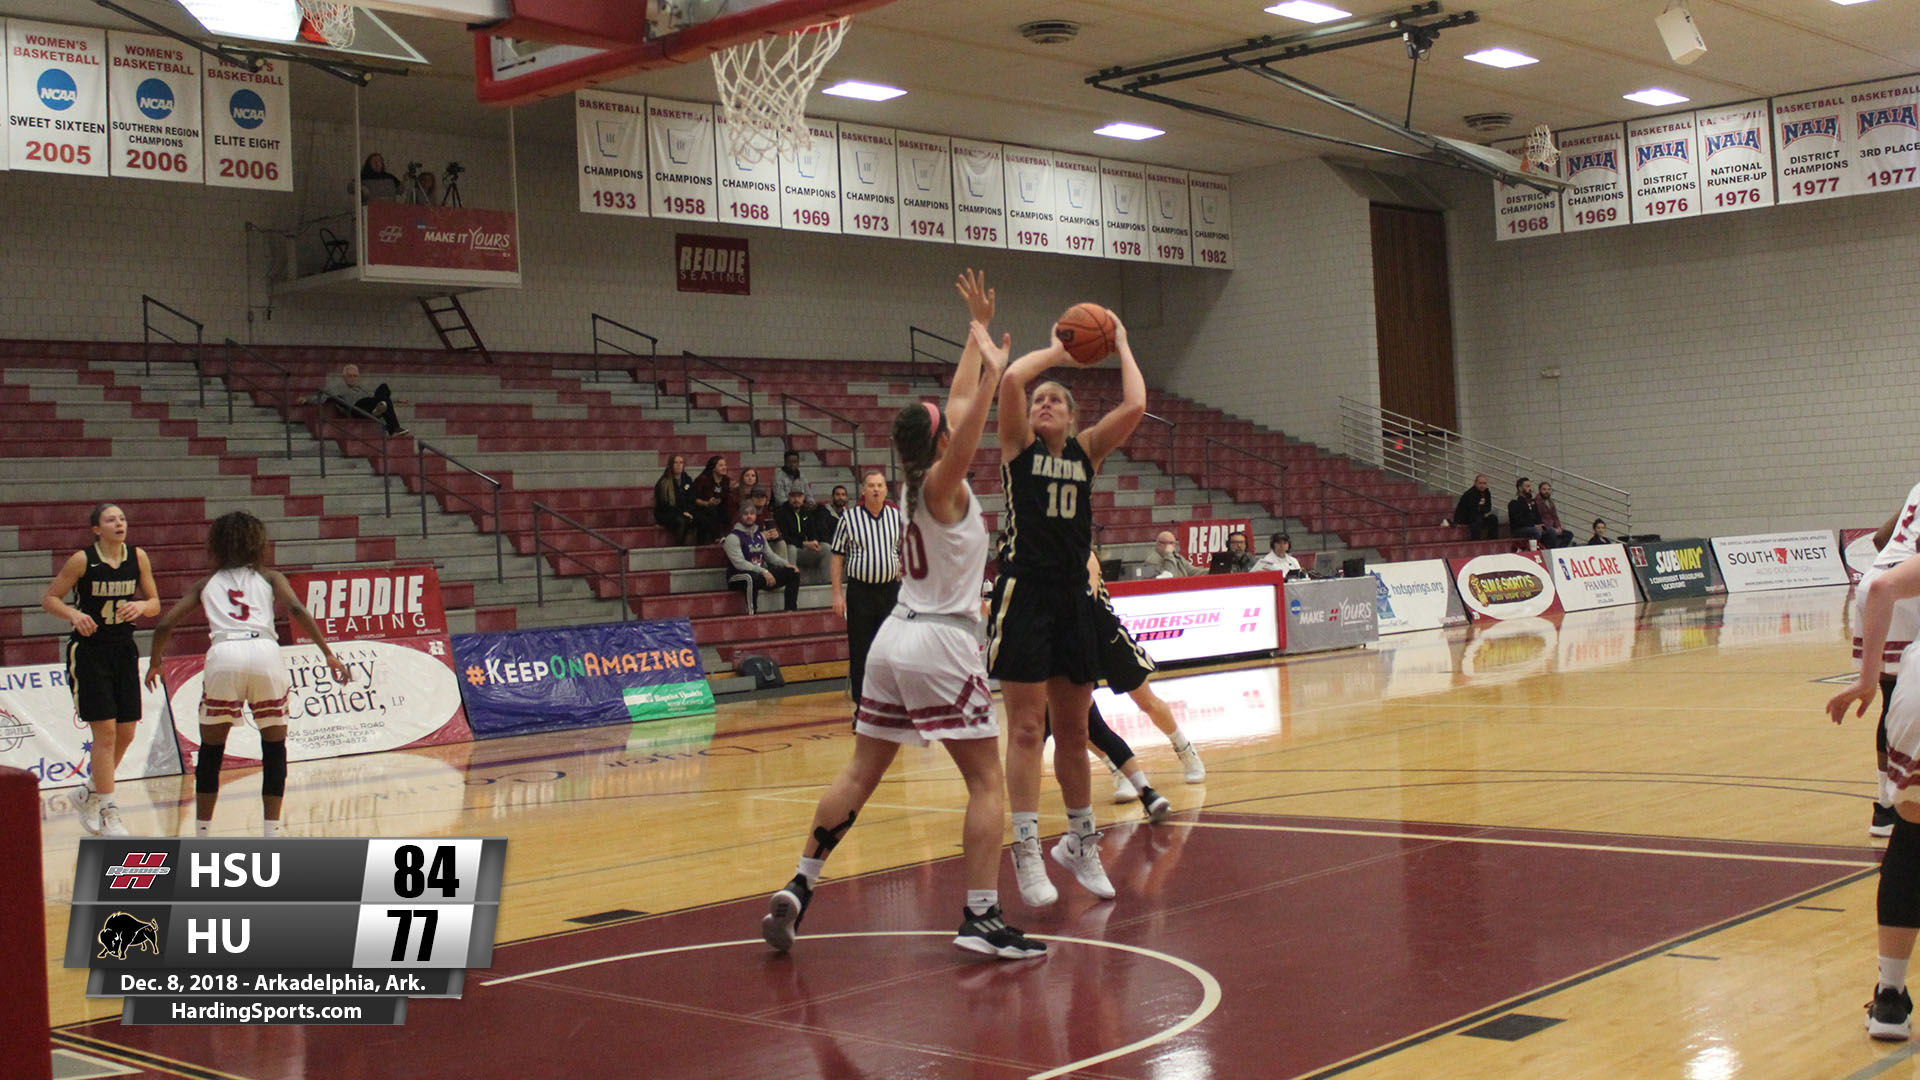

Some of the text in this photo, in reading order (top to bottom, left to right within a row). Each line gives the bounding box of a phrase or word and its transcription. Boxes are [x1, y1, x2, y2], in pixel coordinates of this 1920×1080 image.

[25, 34, 88, 51] WOMEN'S
[13, 47, 100, 66] BASKETBALL
[124, 45, 183, 61] WOMEN'S
[113, 57, 194, 76] BASKETBALL
[208, 69, 284, 86] BASKETBALL
[40, 87, 76, 102] NCAA
[140, 97, 174, 111] NCAA
[579, 99, 640, 114] BASKETBALL
[1776, 97, 1845, 114] BASKETBALL
[232, 107, 265, 120] NCAA
[10, 115, 105, 134] SWEET SIXTEEN
[112, 121, 199, 138] SOUTHERN REGION
[1630, 121, 1692, 138] BASKETBALL
[1859, 106, 1918, 138] NAIA
[841, 131, 893, 146] BASKETBALL
[1561, 132, 1620, 148] BASKETBALL
[1784, 117, 1838, 149] NAIA
[129, 135, 184, 148] CHAMPIONS
[214, 135, 280, 151] ELITE EIGHT
[1706, 130, 1760, 157] NAIA
[26, 141, 92, 165] 2005
[1638, 141, 1688, 166] NAIA
[1790, 150, 1840, 165] DISTRICT
[1860, 142, 1920, 158] 3RD PLACE
[126, 149, 188, 173] 2006
[1055, 160, 1097, 173] BASKETBALL
[1568, 150, 1616, 176] NAIA
[1710, 162, 1763, 176] NATIONAL
[1784, 160, 1848, 176] CHAMPIONS
[220, 158, 279, 181] 2006
[584, 165, 643, 180] CHAMPIONS
[1102, 167, 1144, 180] BASKETBALL
[1867, 167, 1916, 187] 1977
[655, 172, 713, 186] CHAMPIONS
[722, 178, 776, 192] CHAMPIONS
[1643, 172, 1688, 185] DISTRICT
[1707, 171, 1767, 188] RUNNER-UP
[1792, 177, 1839, 196] 1977
[785, 185, 836, 199] CHAMPIONS
[1573, 182, 1617, 195] DISTRICT
[1637, 182, 1696, 197] CHAMPIONS
[592, 190, 637, 210] 1933
[846, 191, 895, 204] CHAMPIONS
[903, 198, 949, 211] CHAMPIONS
[1568, 192, 1624, 206] CHAMPIONS
[1715, 188, 1760, 206] 1976
[663, 196, 706, 215] 1958
[730, 202, 769, 220] 1968
[958, 203, 1002, 216] CHAMPIONS
[1501, 201, 1556, 215] CHAMPIONS
[1645, 198, 1688, 216] 1976
[792, 209, 830, 227] 1969
[853, 214, 889, 231] 1973
[1010, 209, 1053, 221] CHAMPIONS
[1059, 214, 1100, 227] CHAMPIONS
[1575, 207, 1617, 225] 1969
[910, 219, 945, 237] 1974
[1107, 220, 1146, 232] CHAMPIONS
[1151, 224, 1188, 237] CHAMPIONS
[1508, 216, 1549, 234] 1968
[424, 226, 511, 250] MAKE IT YOURS
[964, 225, 998, 242] 1975
[1017, 231, 1049, 247] 1976
[1194, 229, 1230, 241] CHAMPIONS
[1065, 235, 1094, 252] 1977
[1112, 241, 1141, 256] 1978
[680, 246, 746, 273] REDDIE
[1157, 245, 1185, 260] 1979
[1200, 249, 1228, 264] 1982
[680, 270, 746, 285] SEATING
[1046, 482, 1079, 519] 10
[1656, 546, 1703, 574] SUBWAY
[1727, 546, 1827, 565] SOUTH WEST
[1391, 581, 1445, 596] hotsprings.org
[227, 589, 250, 621] 5
[306, 575, 424, 620] REDDIE
[1300, 611, 1325, 625] MAKE
[1339, 598, 1372, 626] YOURS
[326, 612, 426, 634] EATING
[1120, 611, 1222, 631] ENDERSON
[1138, 629, 1182, 642] STATE
[391, 696, 405, 707] LP
[360, 720, 386, 729] ROAD
